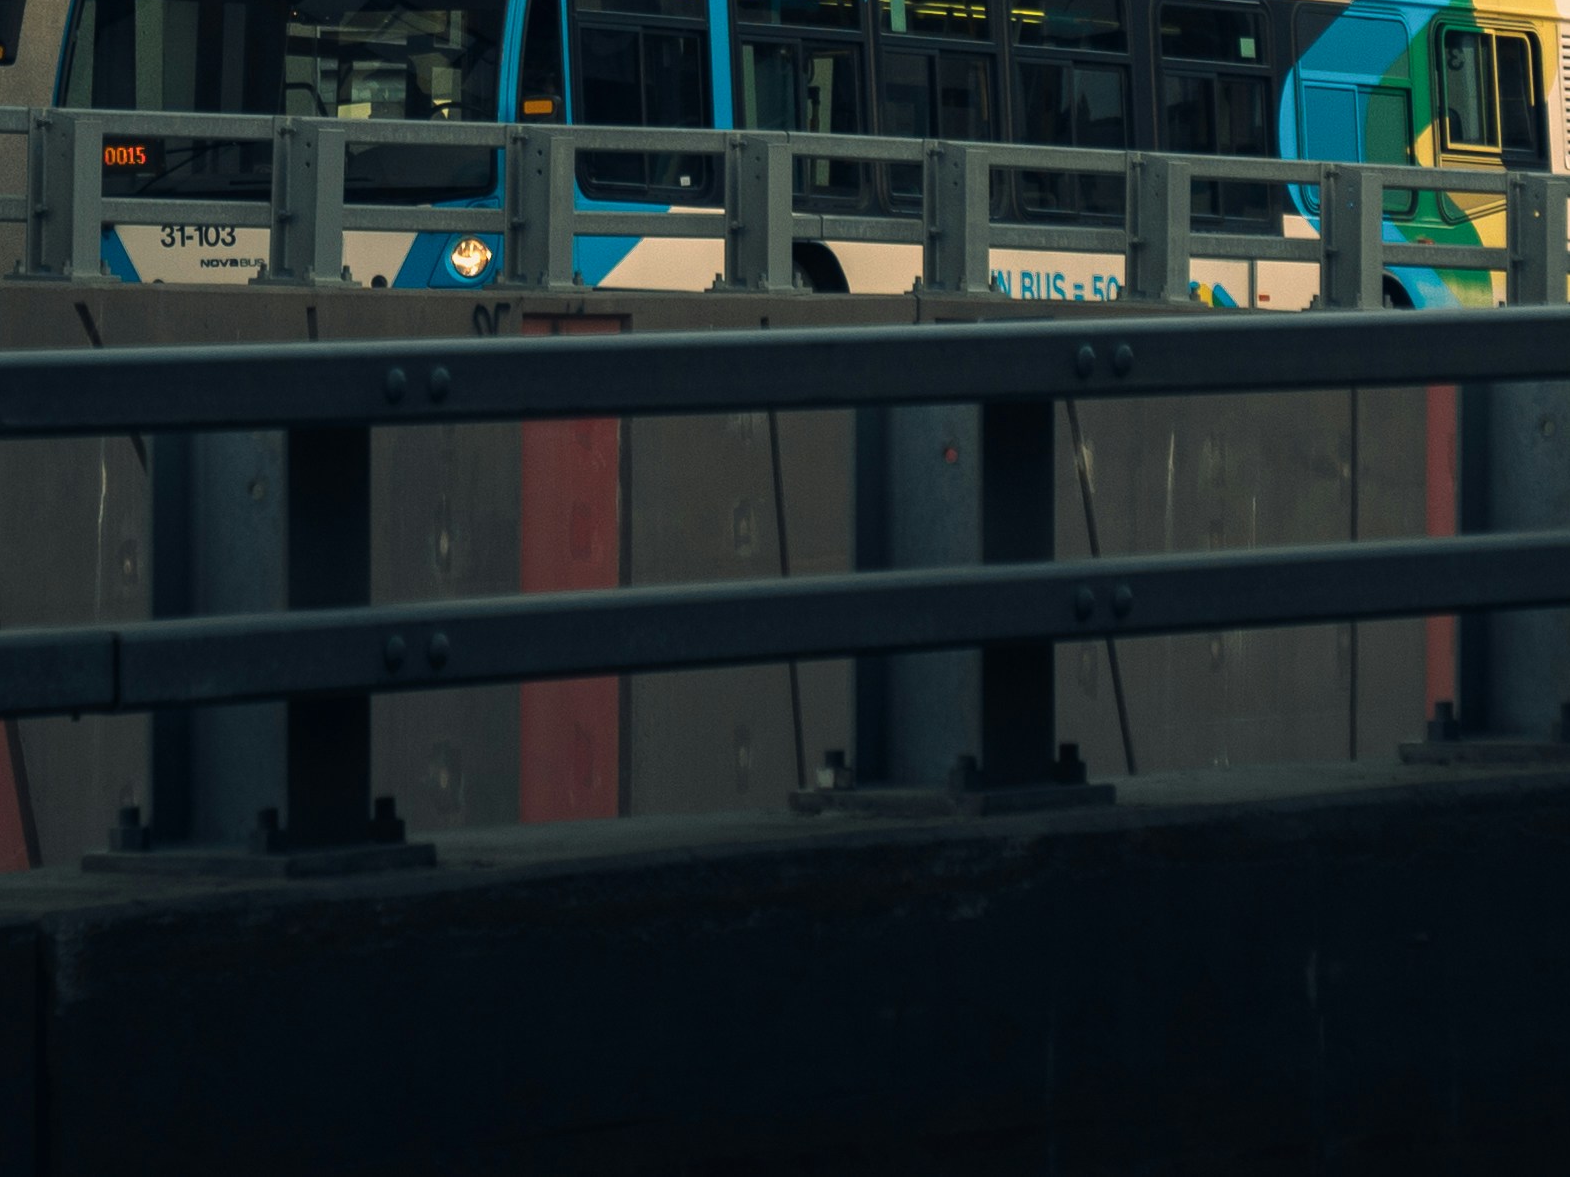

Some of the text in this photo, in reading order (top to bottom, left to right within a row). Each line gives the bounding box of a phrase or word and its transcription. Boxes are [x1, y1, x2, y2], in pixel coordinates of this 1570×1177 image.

[104, 145, 147, 166] 0015
[160, 224, 237, 248] 31-103
[1021, 270, 1067, 300] BUS
